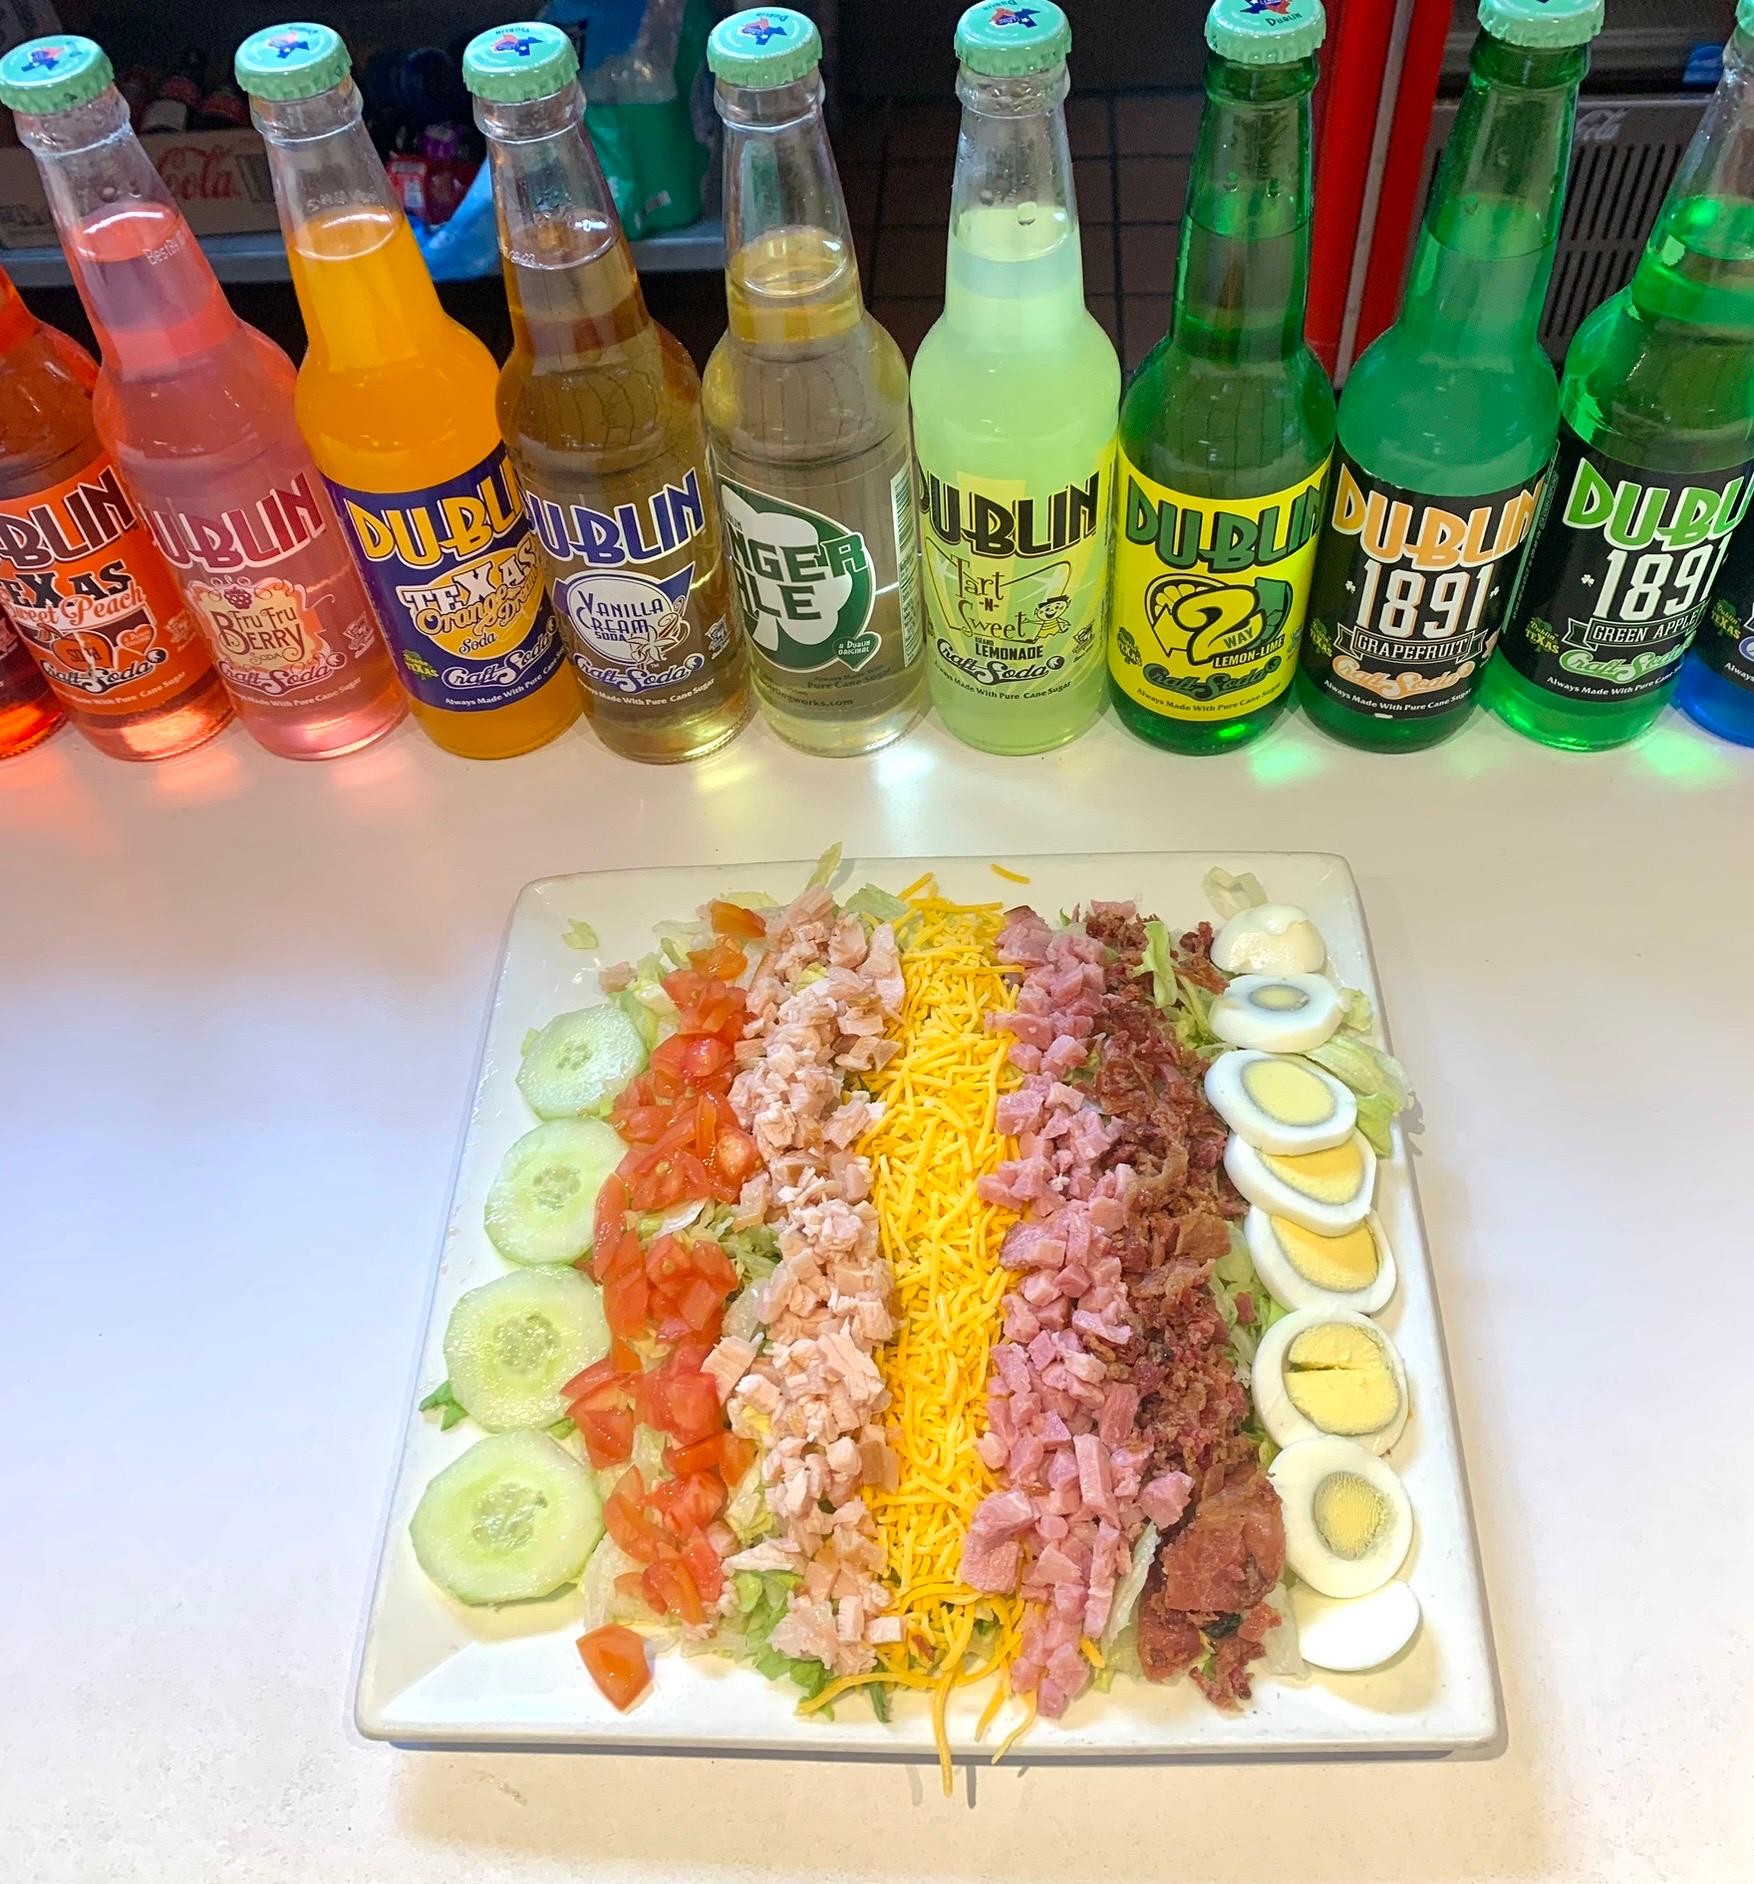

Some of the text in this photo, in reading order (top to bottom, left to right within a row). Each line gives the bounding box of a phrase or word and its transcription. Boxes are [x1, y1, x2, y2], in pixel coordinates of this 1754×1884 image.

[0, 465, 137, 568] BLIN
[138, 471, 326, 573] UBLIN
[343, 457, 529, 570] DUBLI
[727, 531, 869, 582] NGER
[0, 558, 132, 608] EXAS
[397, 533, 539, 616] TEXAS
[950, 554, 1004, 600] Tart
[59, 580, 145, 626] Peach
[577, 590, 664, 619] VANILLA
[1356, 559, 1495, 639] 1891
[229, 606, 298, 633] Fru Fru
[575, 606, 649, 634] CREAM
[957, 599, 1030, 638] Sweet
[1592, 611, 1700, 643] GREEN APPLE
[210, 610, 306, 662] BERRY
[459, 632, 498, 655] Soda
[594, 631, 627, 642] SODA
[838, 647, 870, 656] ORIGINAL
[1213, 633, 1286, 669] LEMON-LIME
[1223, 627, 1254, 650] WAY
[1357, 635, 1468, 661] GRAPEFRUIT
[1525, 628, 1560, 655] TEXAS
[936, 638, 1049, 686] Craft Soda
[975, 644, 1044, 661] LEMONADE
[1559, 649, 1627, 682] Craft
[260, 663, 332, 696] Soda
[441, 662, 502, 690] Craft
[618, 663, 692, 695] Soda
[807, 679, 833, 690] Pure
[833, 679, 863, 688] Cane
[976, 687, 998, 699] With
[999, 692, 1020, 700] Pure
[1023, 691, 1046, 700] Cane
[1047, 681, 1072, 695] Sugar
[1546, 676, 1580, 693] Always
[1580, 686, 1609, 696] Made
[1611, 685, 1634, 695] With
[1634, 680, 1656, 692] Pure
[502, 686, 526, 699] With
[669, 690, 693, 703] Cane
[1137, 688, 1165, 705] Always
[1166, 700, 1191, 712] Made
[1193, 704, 1216, 712] With
[1217, 703, 1239, 712] Pure
[1323, 679, 1351, 699] Always
[1351, 694, 1378, 708] Made
[1379, 702, 1403, 711] With
[1404, 703, 1427, 711] Pure
[1427, 699, 1451, 709] Cane
